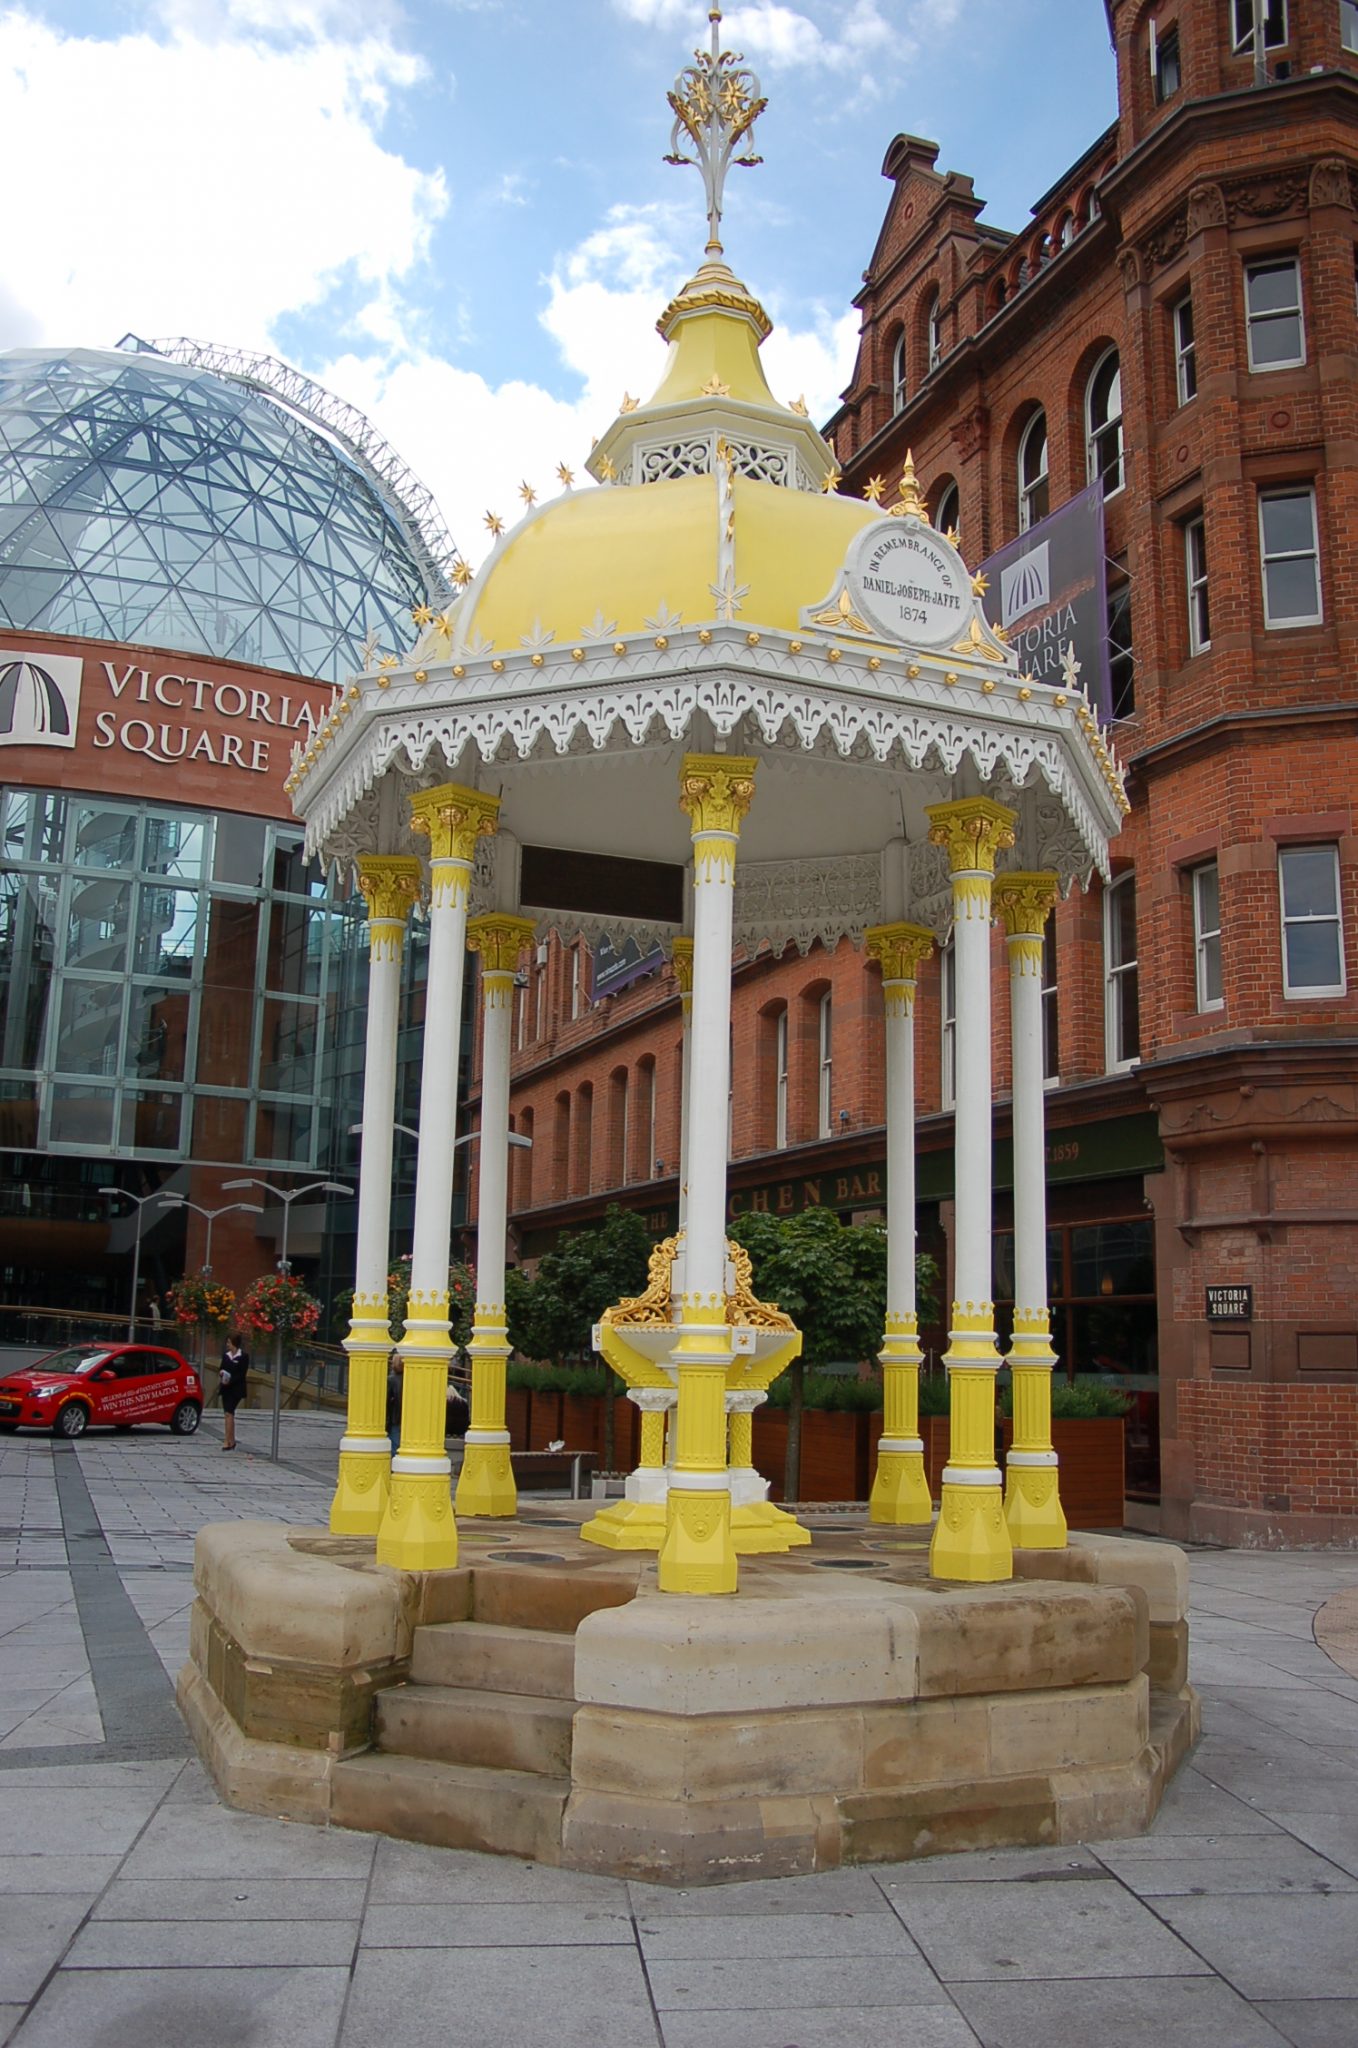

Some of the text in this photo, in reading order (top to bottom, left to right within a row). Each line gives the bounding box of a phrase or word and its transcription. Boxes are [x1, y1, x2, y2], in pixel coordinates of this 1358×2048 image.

[869, 537, 953, 589] IN REMEMBRANCE OF
[899, 605, 928, 624] 1874
[931, 592, 960, 610] JAFFE
[1011, 602, 1078, 659] TORIA
[100, 661, 319, 734] VICTORIA
[93, 711, 271, 772] SQUARE
[728, 1178, 822, 1217] CHEN
[836, 1171, 882, 1200] BAR
[1208, 1289, 1248, 1301] VICTORIA
[1212, 1303, 1245, 1315] SQUARE
[102, 1401, 118, 1412] WIN
[119, 1398, 134, 1408] THIS
[135, 1393, 151, 1403] NEW
